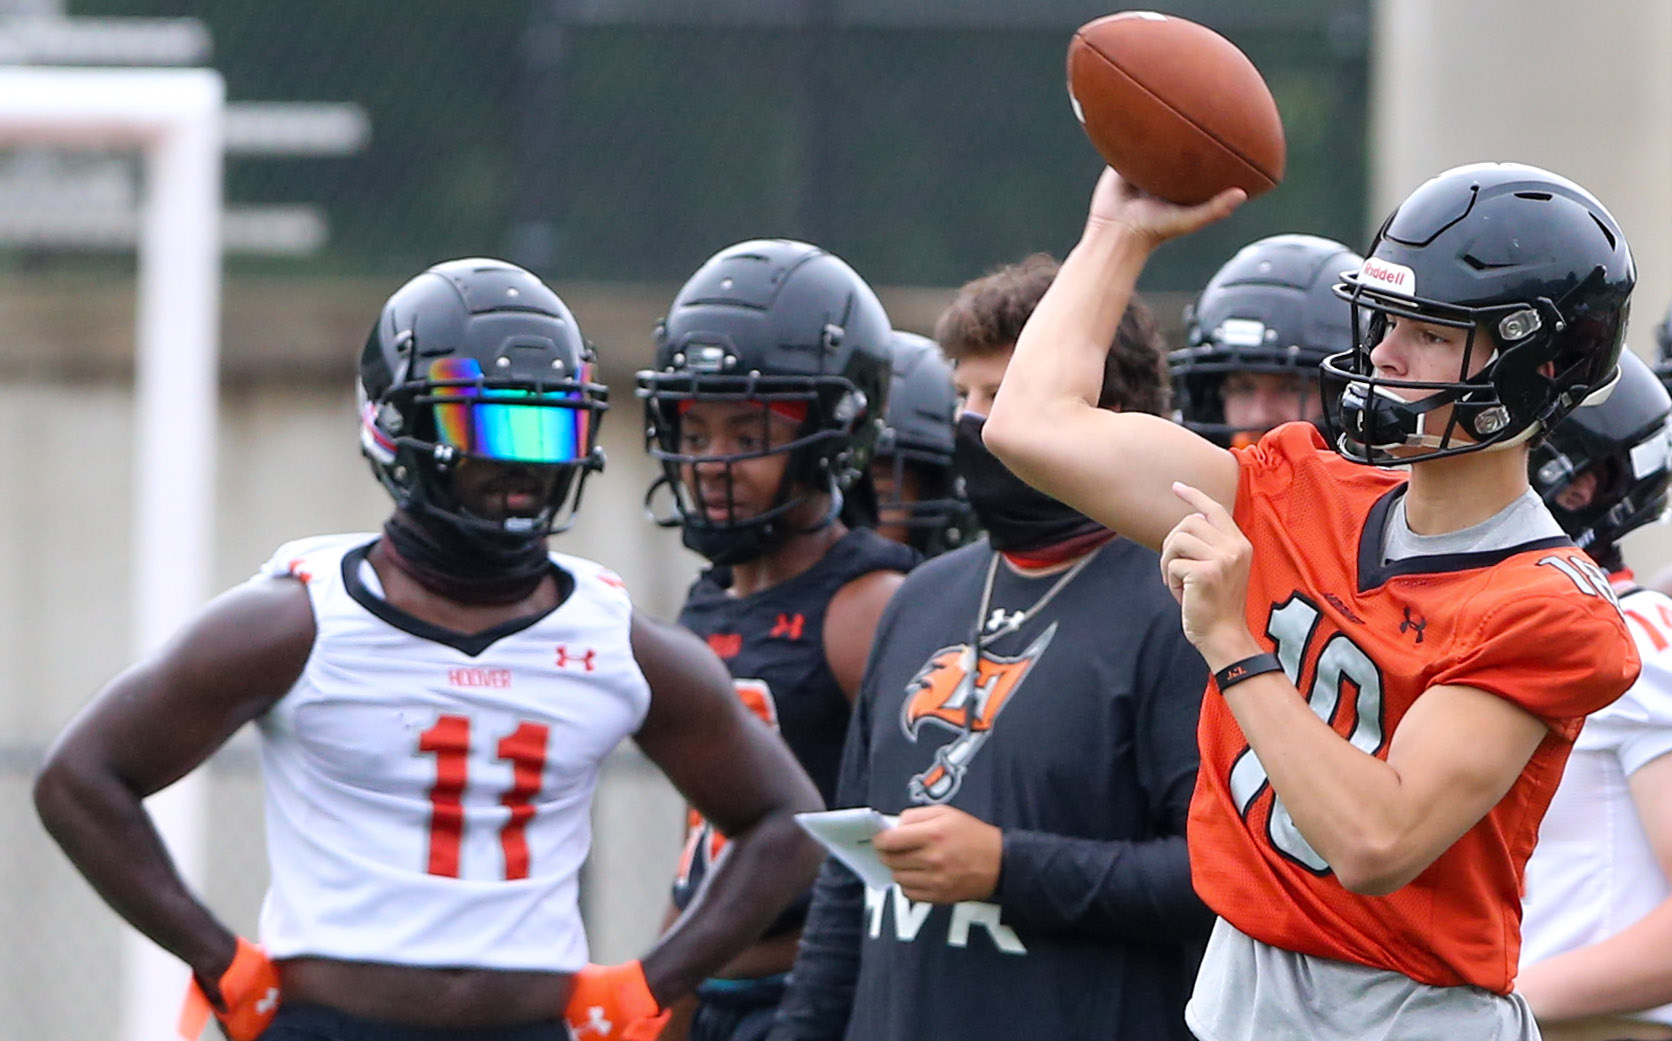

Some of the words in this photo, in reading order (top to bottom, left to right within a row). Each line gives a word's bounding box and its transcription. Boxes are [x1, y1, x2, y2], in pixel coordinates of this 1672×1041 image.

[1364, 262, 1405, 285] Riddell
[448, 669, 511, 688] HOOVER
[418, 714, 550, 881] 11
